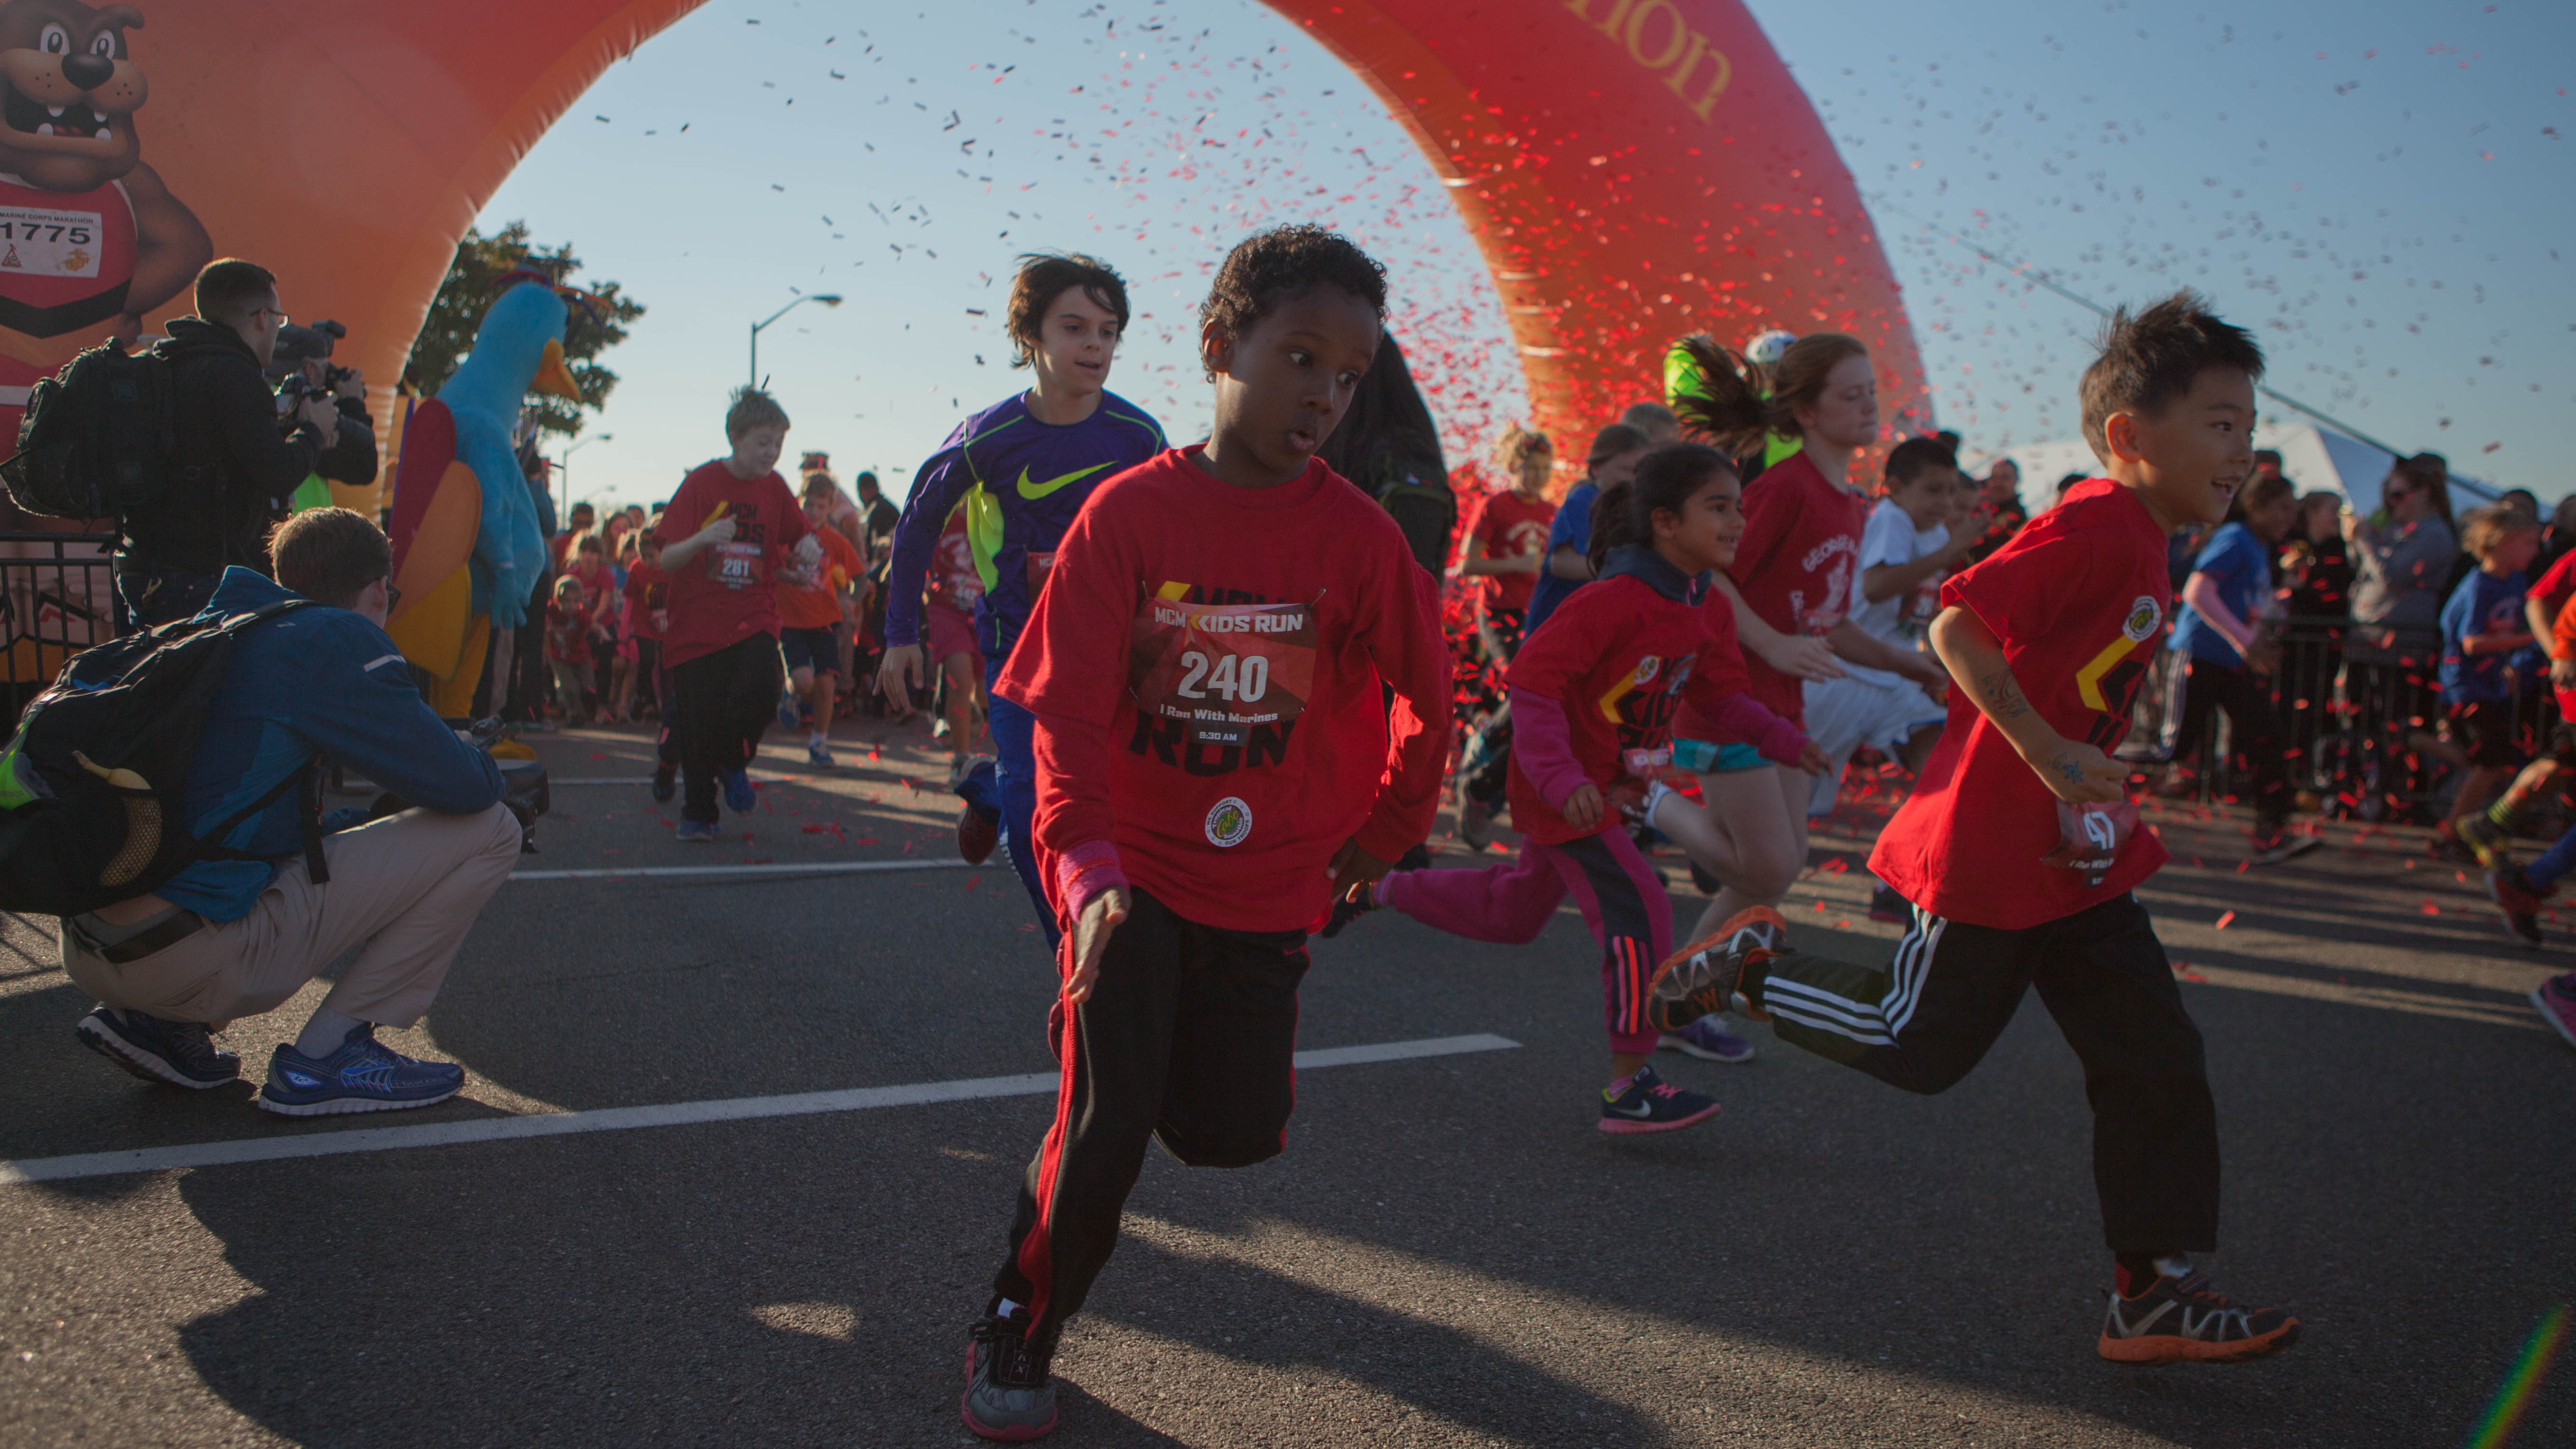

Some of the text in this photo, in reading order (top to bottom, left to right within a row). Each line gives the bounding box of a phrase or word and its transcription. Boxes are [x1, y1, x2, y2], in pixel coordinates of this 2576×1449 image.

[54, 216, 94, 224] MARATHON
[0, 222, 91, 244] 1775
[1155, 606, 1303, 633] MCM KIDS RUN
[1177, 651, 1269, 703] 240
[1160, 703, 1278, 724] I Ran With Marines
[1199, 731, 1237, 741] 9:30 AM
[1210, 800, 1232, 815] SUPPORT
[1212, 806, 1233, 830] Tropical
[1237, 819, 1249, 841] TROOPS
